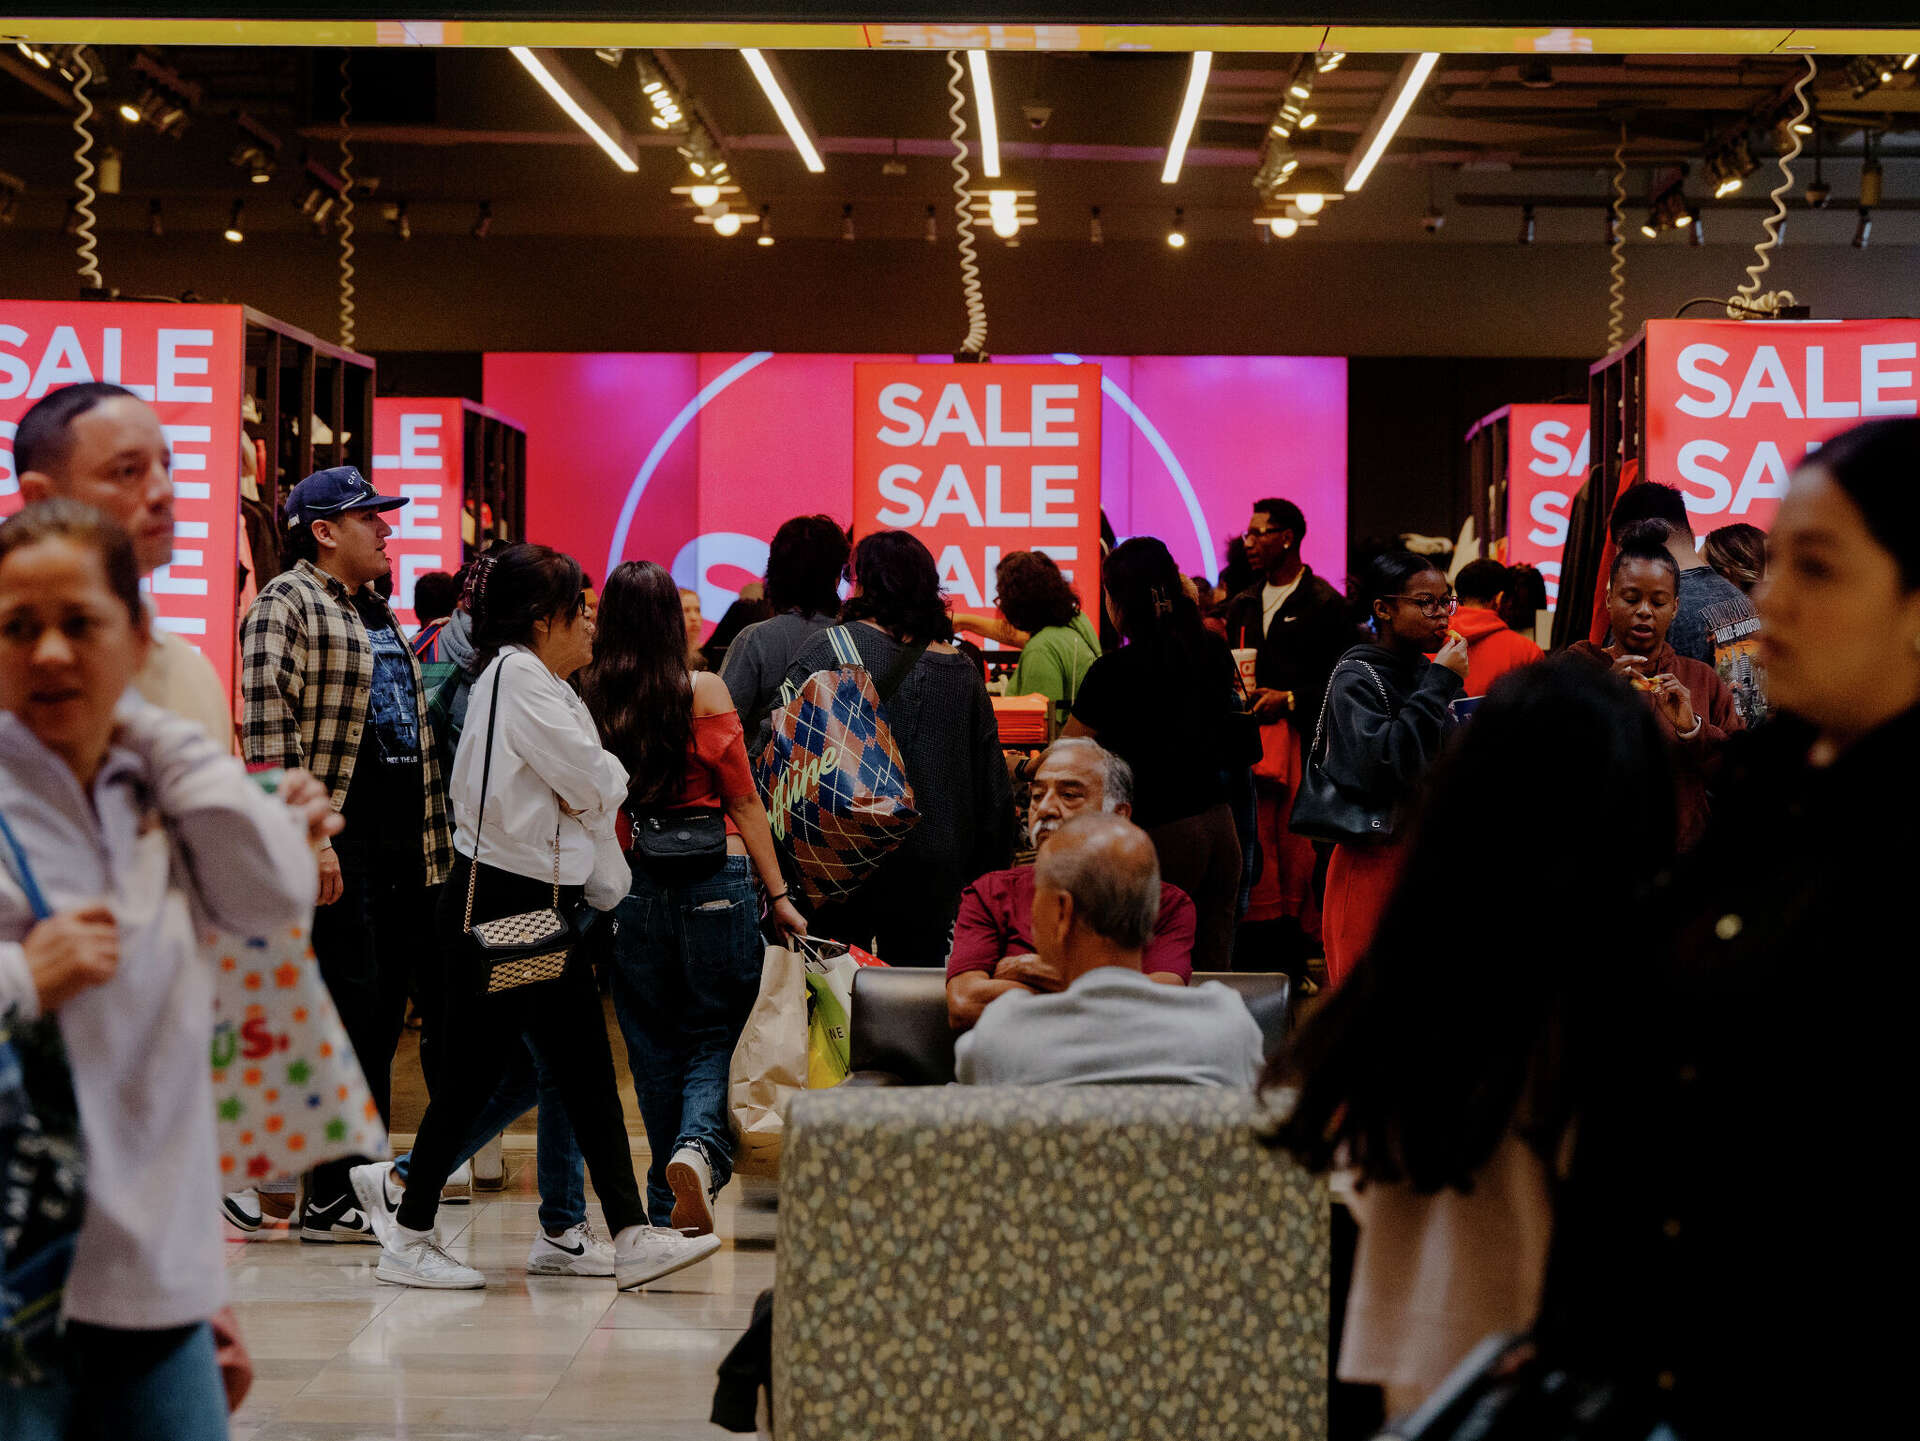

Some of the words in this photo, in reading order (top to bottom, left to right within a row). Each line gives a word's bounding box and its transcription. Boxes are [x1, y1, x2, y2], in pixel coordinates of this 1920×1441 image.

[1675, 343, 1917, 419] SALE
[876, 383, 1079, 447] SALE
[875, 464, 1079, 527] SALE
